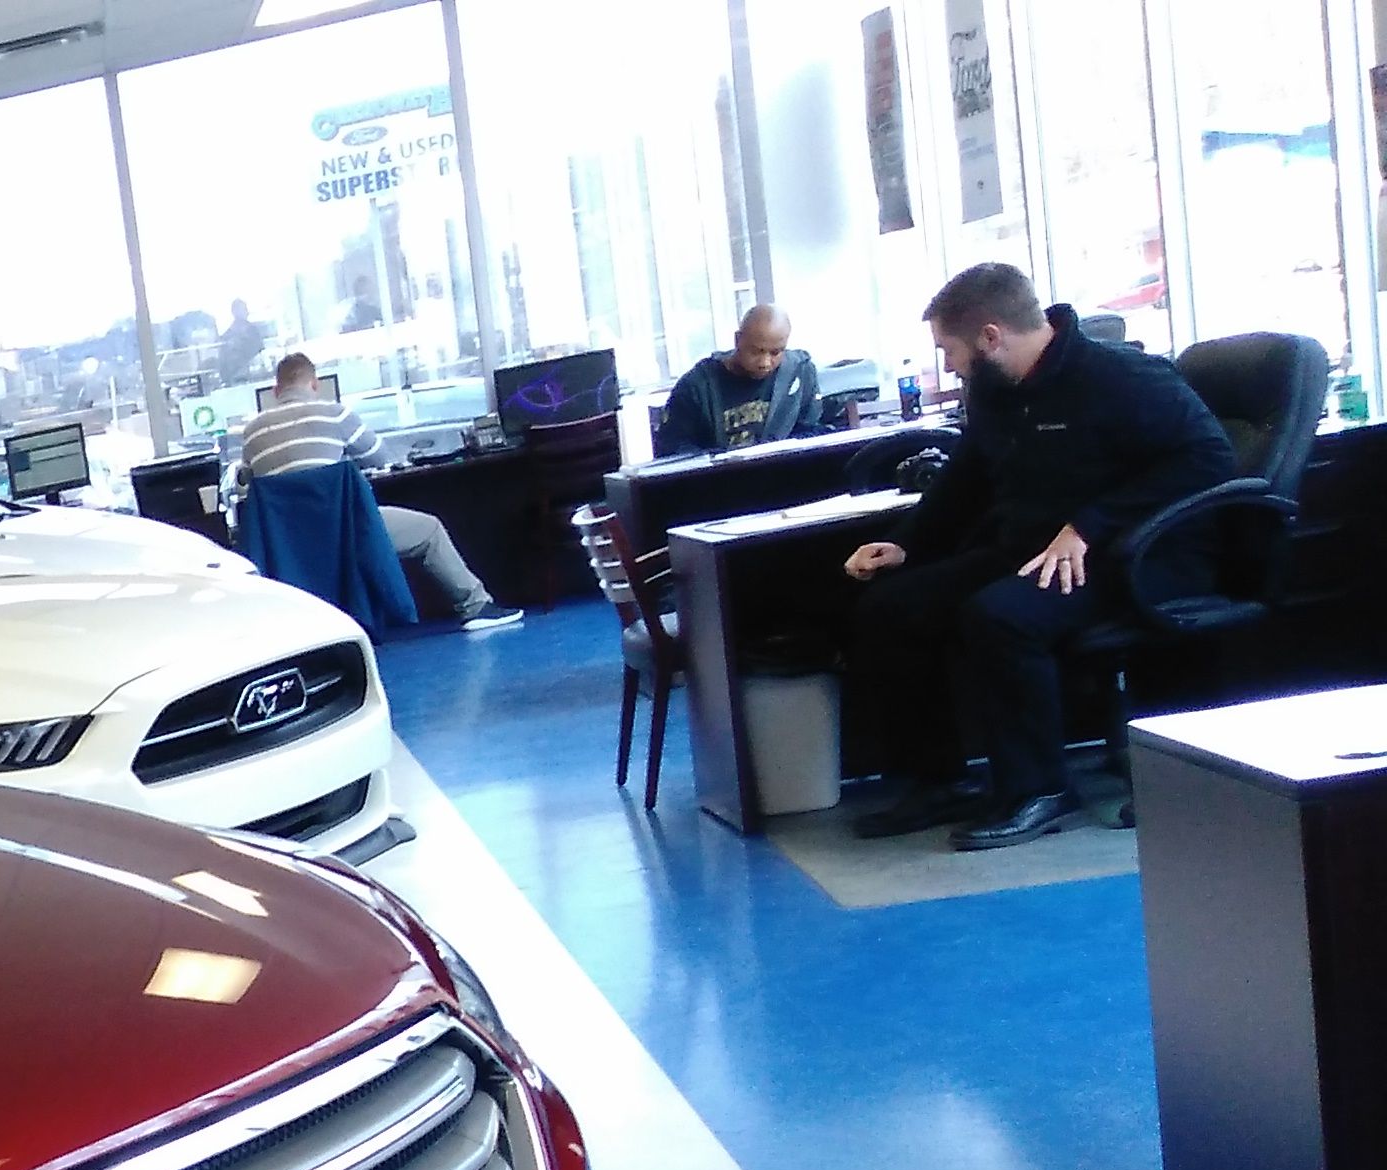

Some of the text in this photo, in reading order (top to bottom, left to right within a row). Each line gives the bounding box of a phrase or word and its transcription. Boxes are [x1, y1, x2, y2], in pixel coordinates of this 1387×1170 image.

[321, 133, 454, 176] NEW & USED
